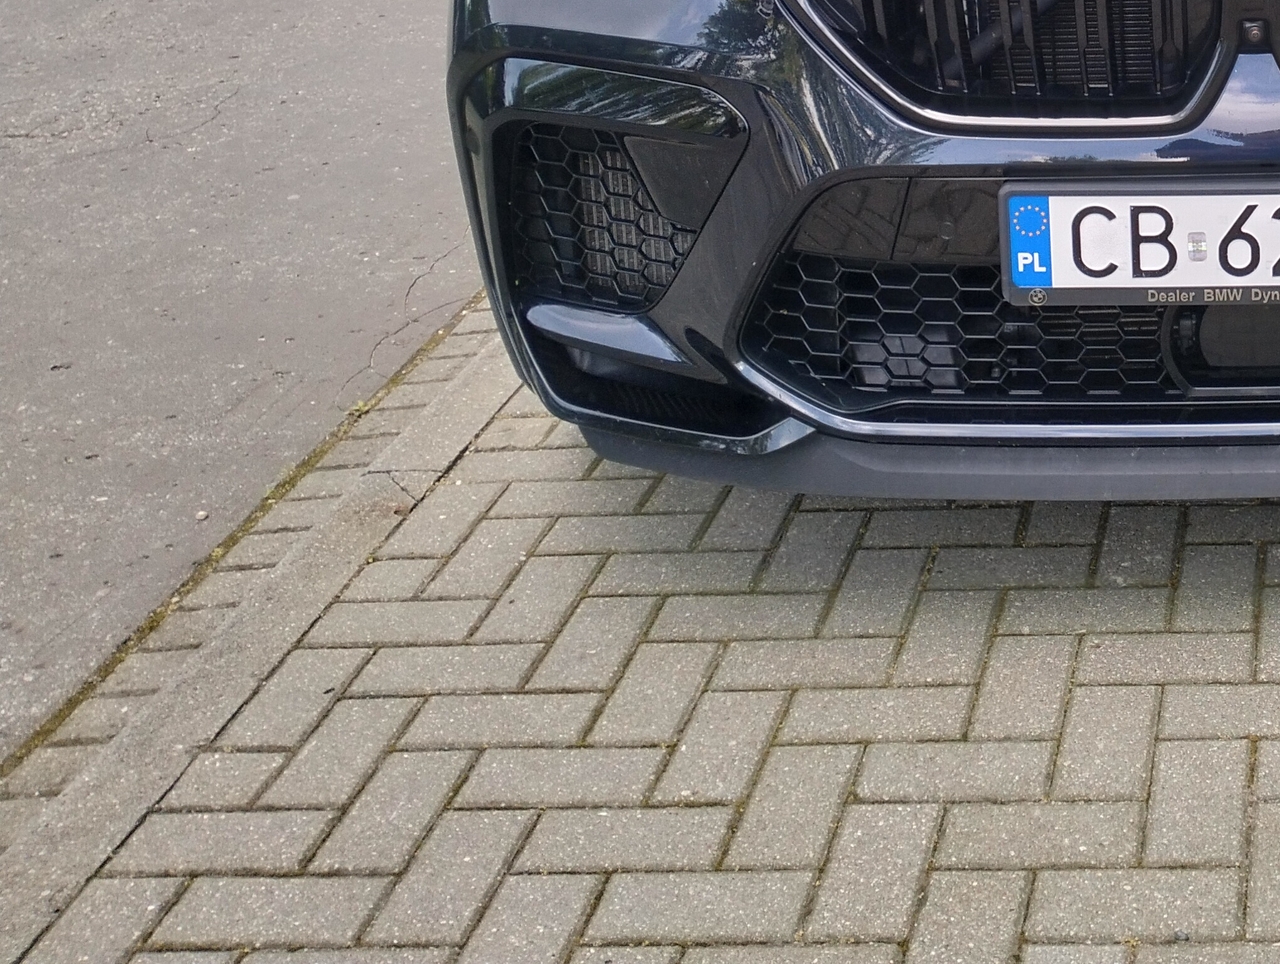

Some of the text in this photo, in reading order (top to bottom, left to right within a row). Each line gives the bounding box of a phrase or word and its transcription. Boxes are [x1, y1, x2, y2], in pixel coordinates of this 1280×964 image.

[1072, 205, 1178, 279] CB
[1017, 252, 1047, 273] PL
[1147, 289, 1196, 303] Dealer
[1203, 288, 1243, 302] BMW
